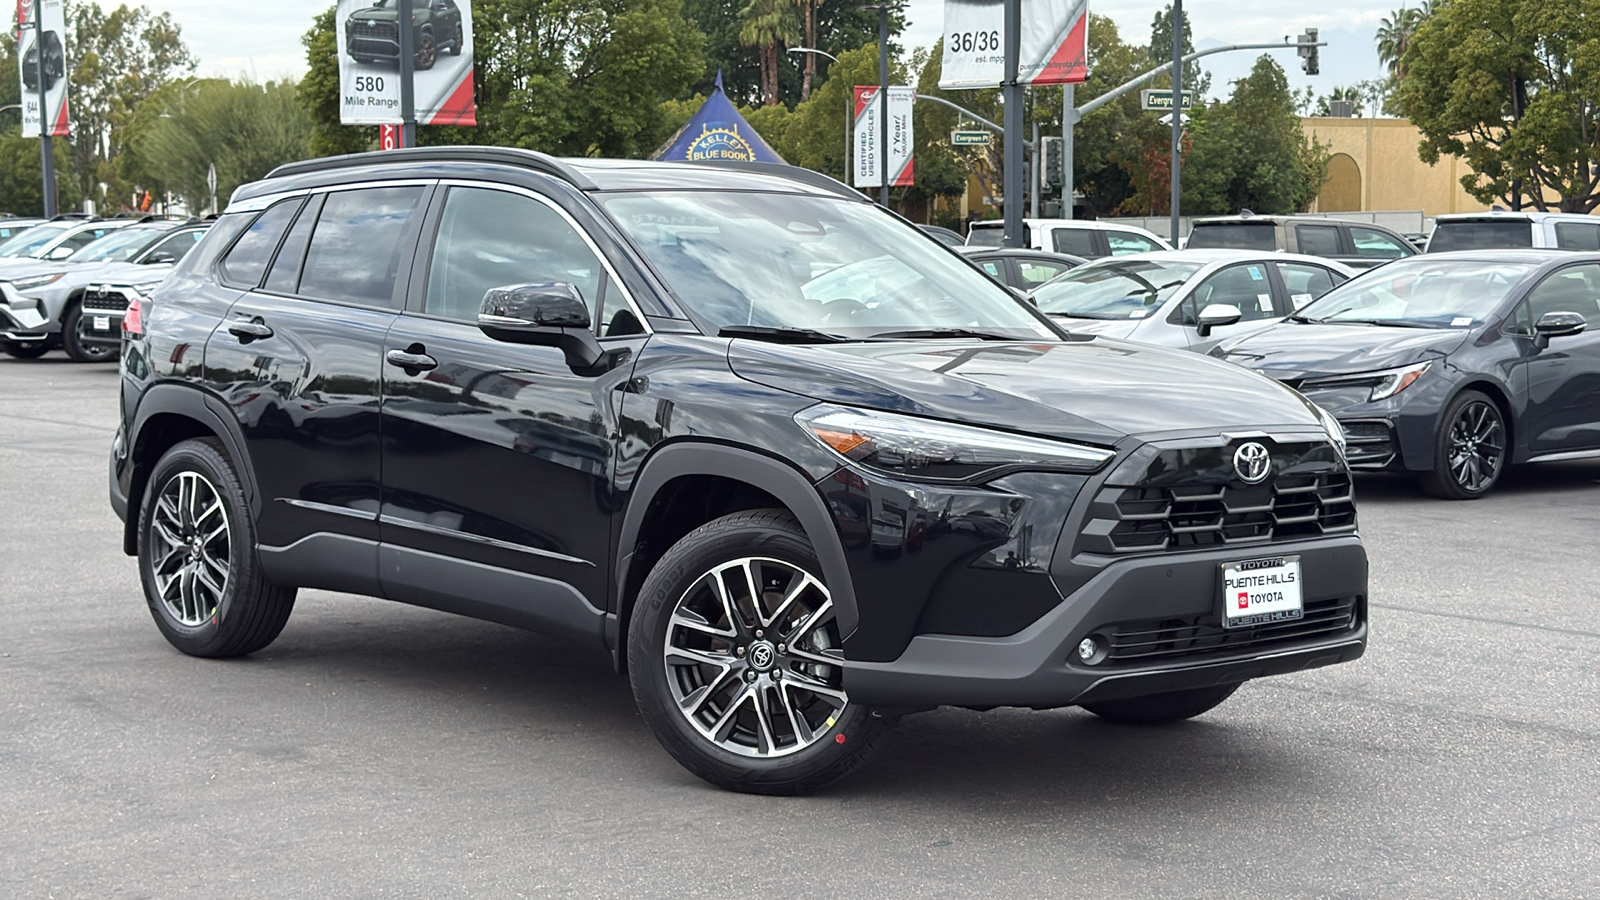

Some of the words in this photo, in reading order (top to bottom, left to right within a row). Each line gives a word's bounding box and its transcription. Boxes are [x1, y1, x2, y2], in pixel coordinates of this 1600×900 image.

[951, 30, 999, 52] 36/36
[975, 55, 988, 63] est.
[989, 55, 1005, 64] mpg
[355, 76, 385, 92] 580
[345, 96, 366, 106] Mile
[367, 96, 399, 109] Range
[893, 115, 901, 145] Year/
[699, 134, 744, 150] KELLEY
[693, 150, 719, 159] BLUE
[720, 150, 748, 161] BOOK
[893, 147, 901, 155] 7
[1242, 559, 1282, 569] TOYOTA
[1225, 575, 1265, 589] PUENTE
[1266, 572, 1295, 585] HILLS
[1250, 591, 1284, 604] TOYOTA
[1230, 613, 1270, 626] PUENTE
[1271, 609, 1300, 621] HILLS
